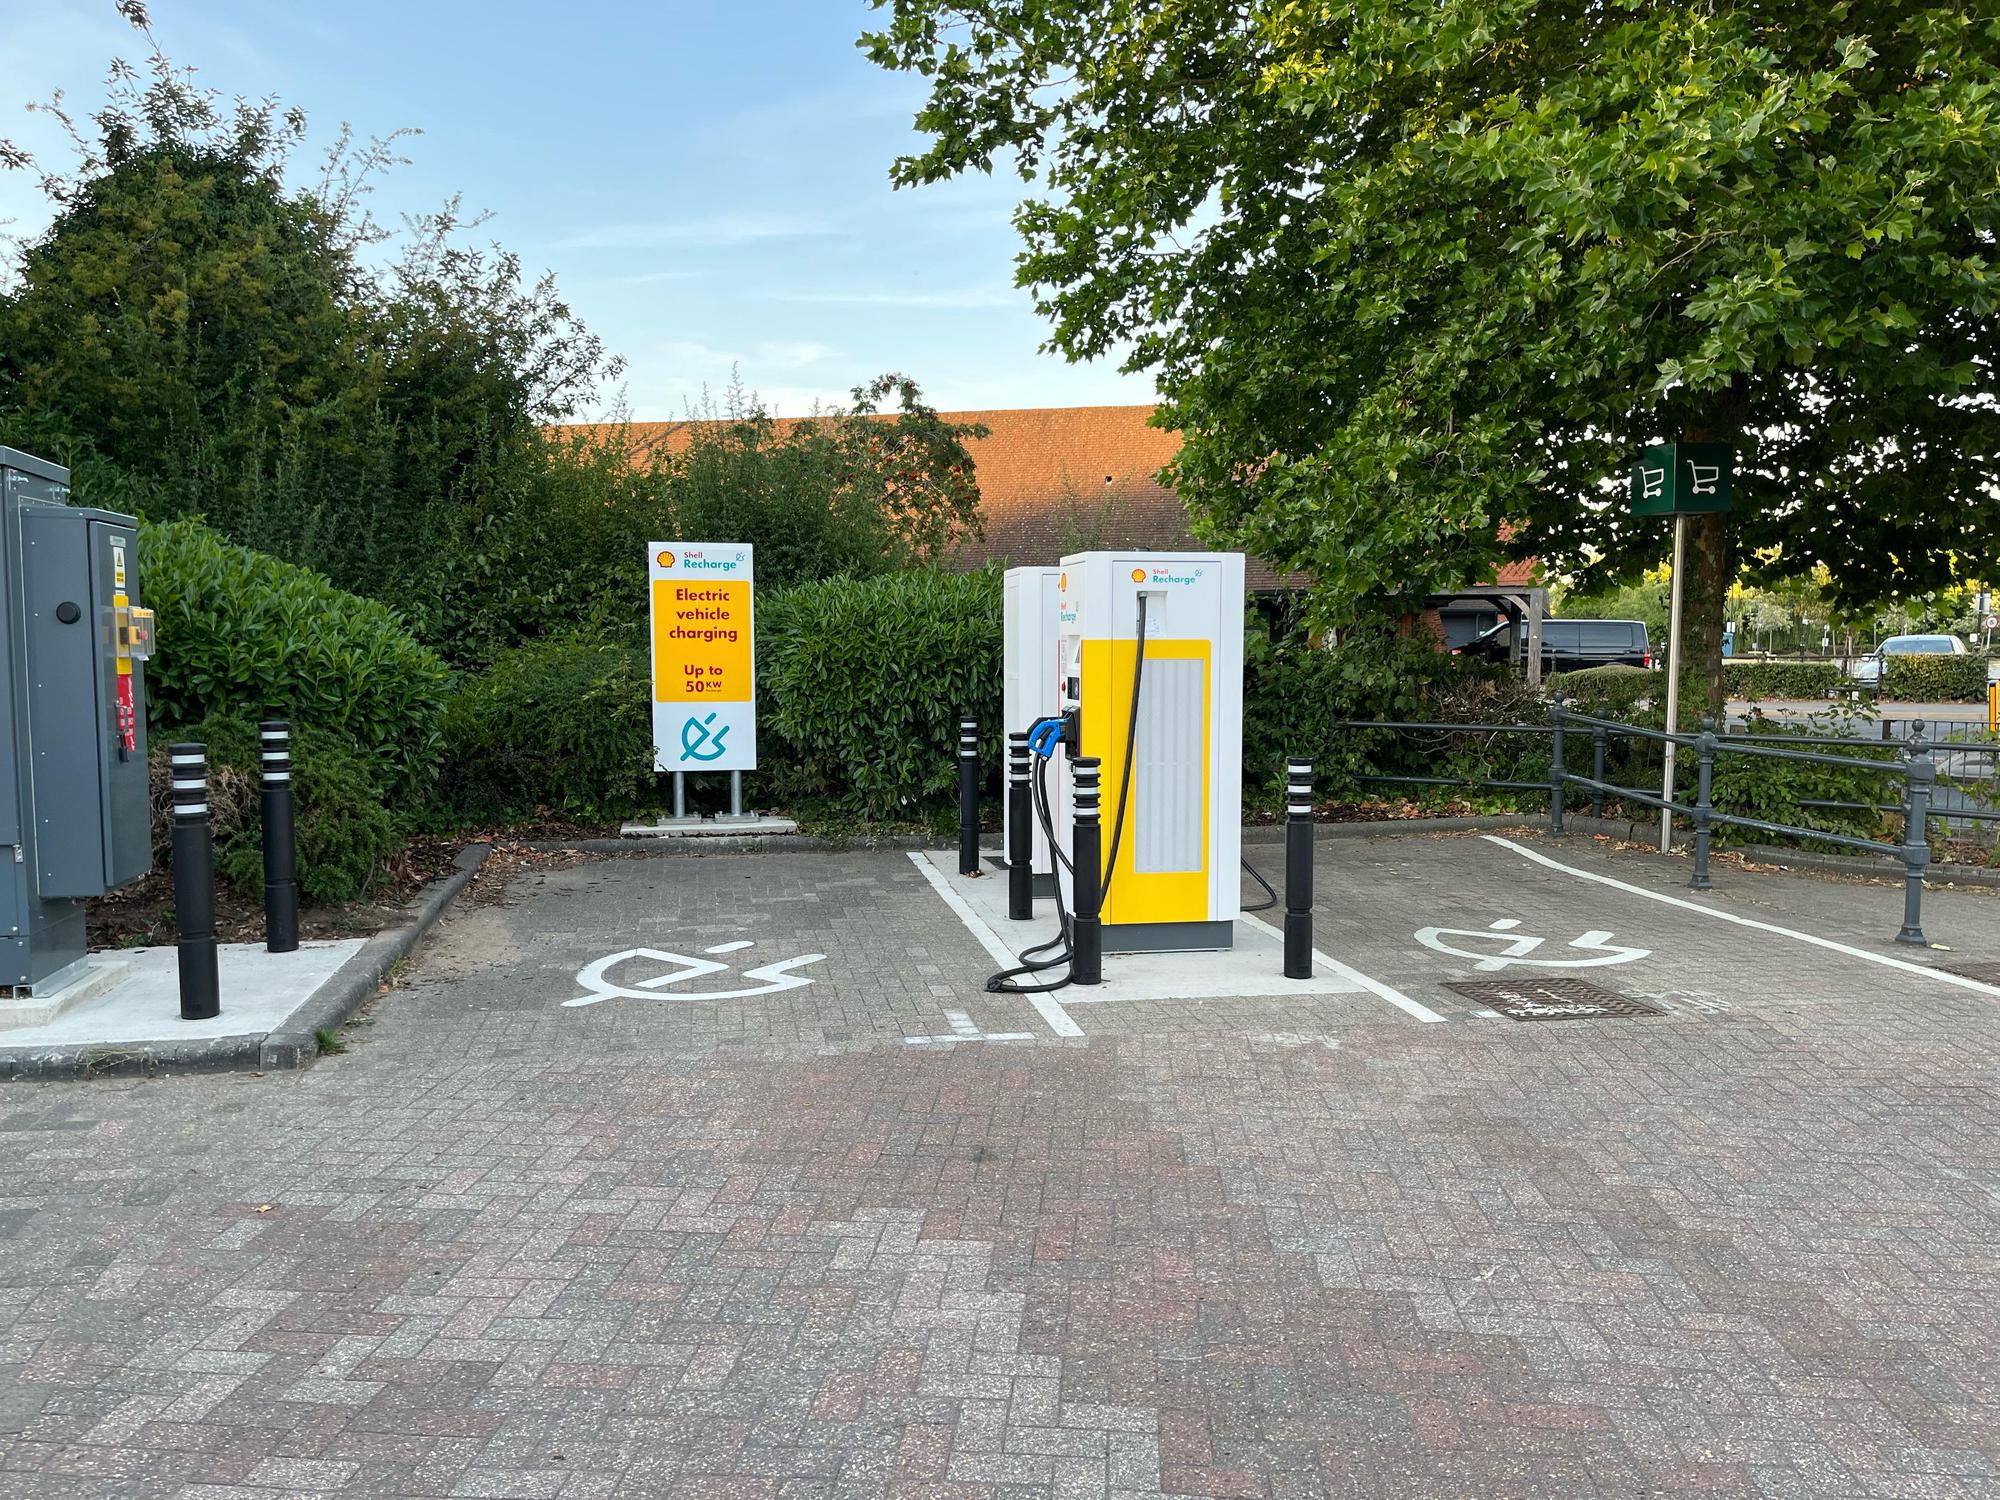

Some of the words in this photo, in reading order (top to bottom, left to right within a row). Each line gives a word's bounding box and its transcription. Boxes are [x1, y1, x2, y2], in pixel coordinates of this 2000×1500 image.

[684, 559, 737, 571] Recharge
[1152, 575, 1196, 586] Recharge
[676, 588, 730, 601] Electric
[676, 607, 730, 620] vehicle
[669, 626, 738, 642] charging
[684, 665, 704, 678] Up
[709, 666, 723, 676] to
